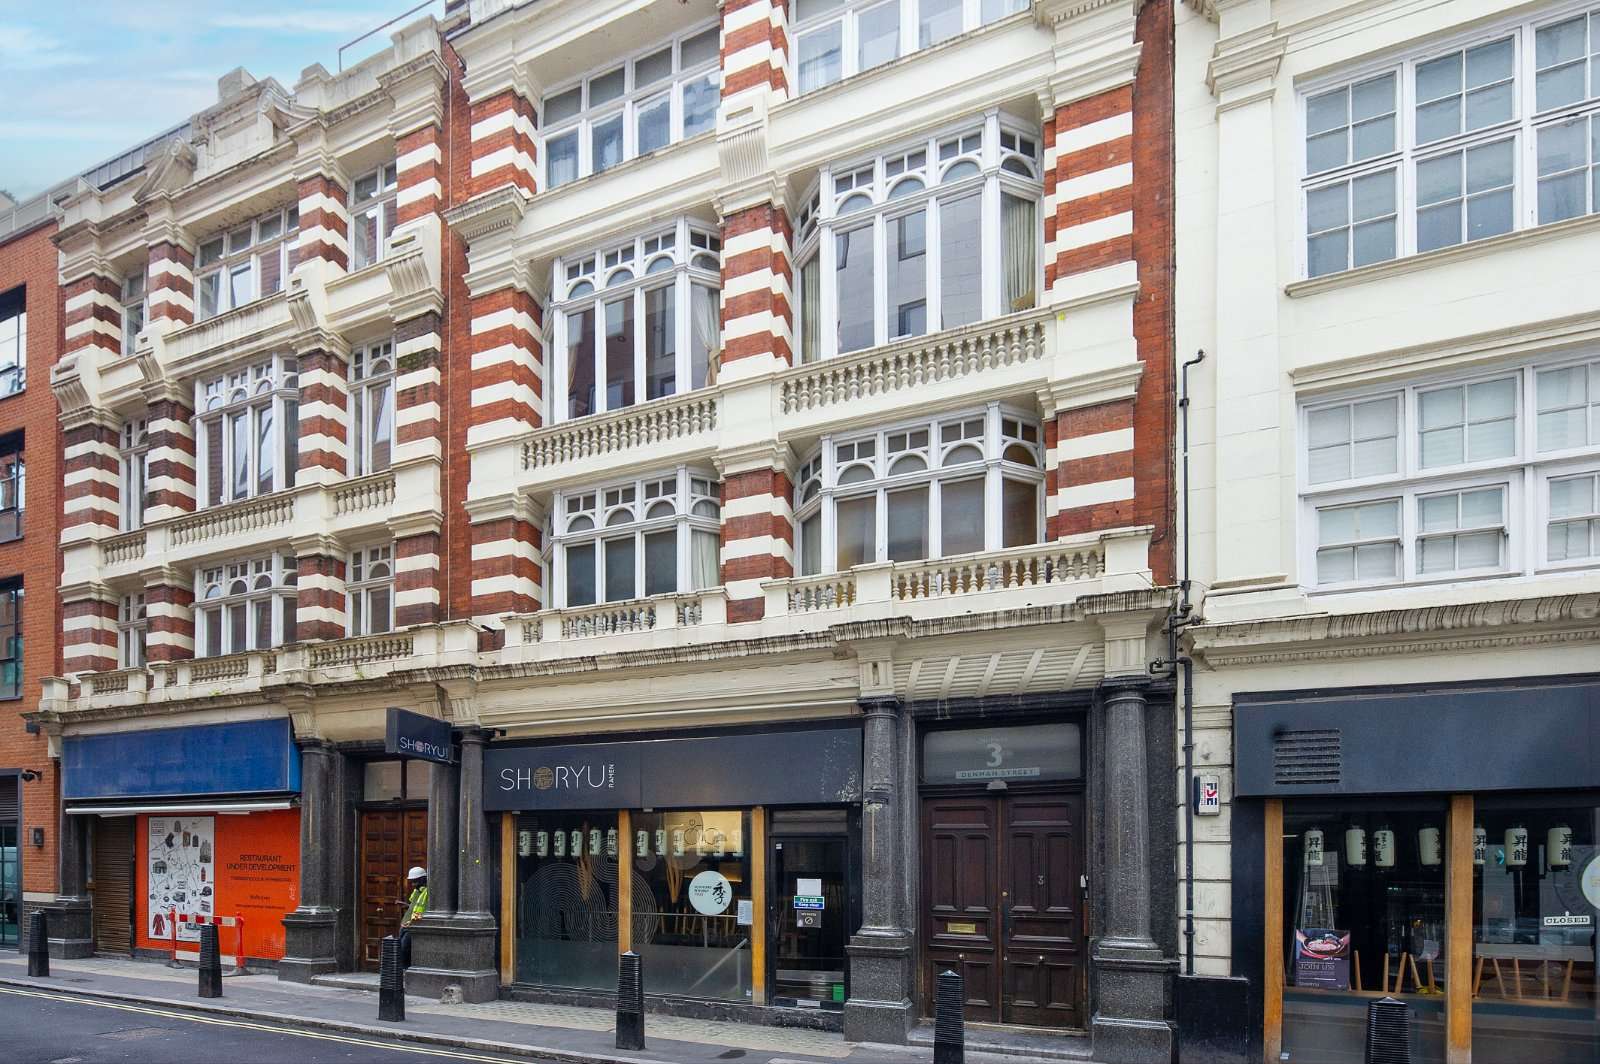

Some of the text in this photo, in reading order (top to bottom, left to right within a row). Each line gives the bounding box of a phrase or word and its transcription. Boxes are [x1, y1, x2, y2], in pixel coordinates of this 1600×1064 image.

[986, 743, 1002, 768] 3
[961, 769, 998, 778] DENMAN
[1511, 834, 1528, 861] 昇龍
[240, 854, 282, 862] RESTAURANT
[226, 863, 296, 872] UNDER DEVELOPMENT
